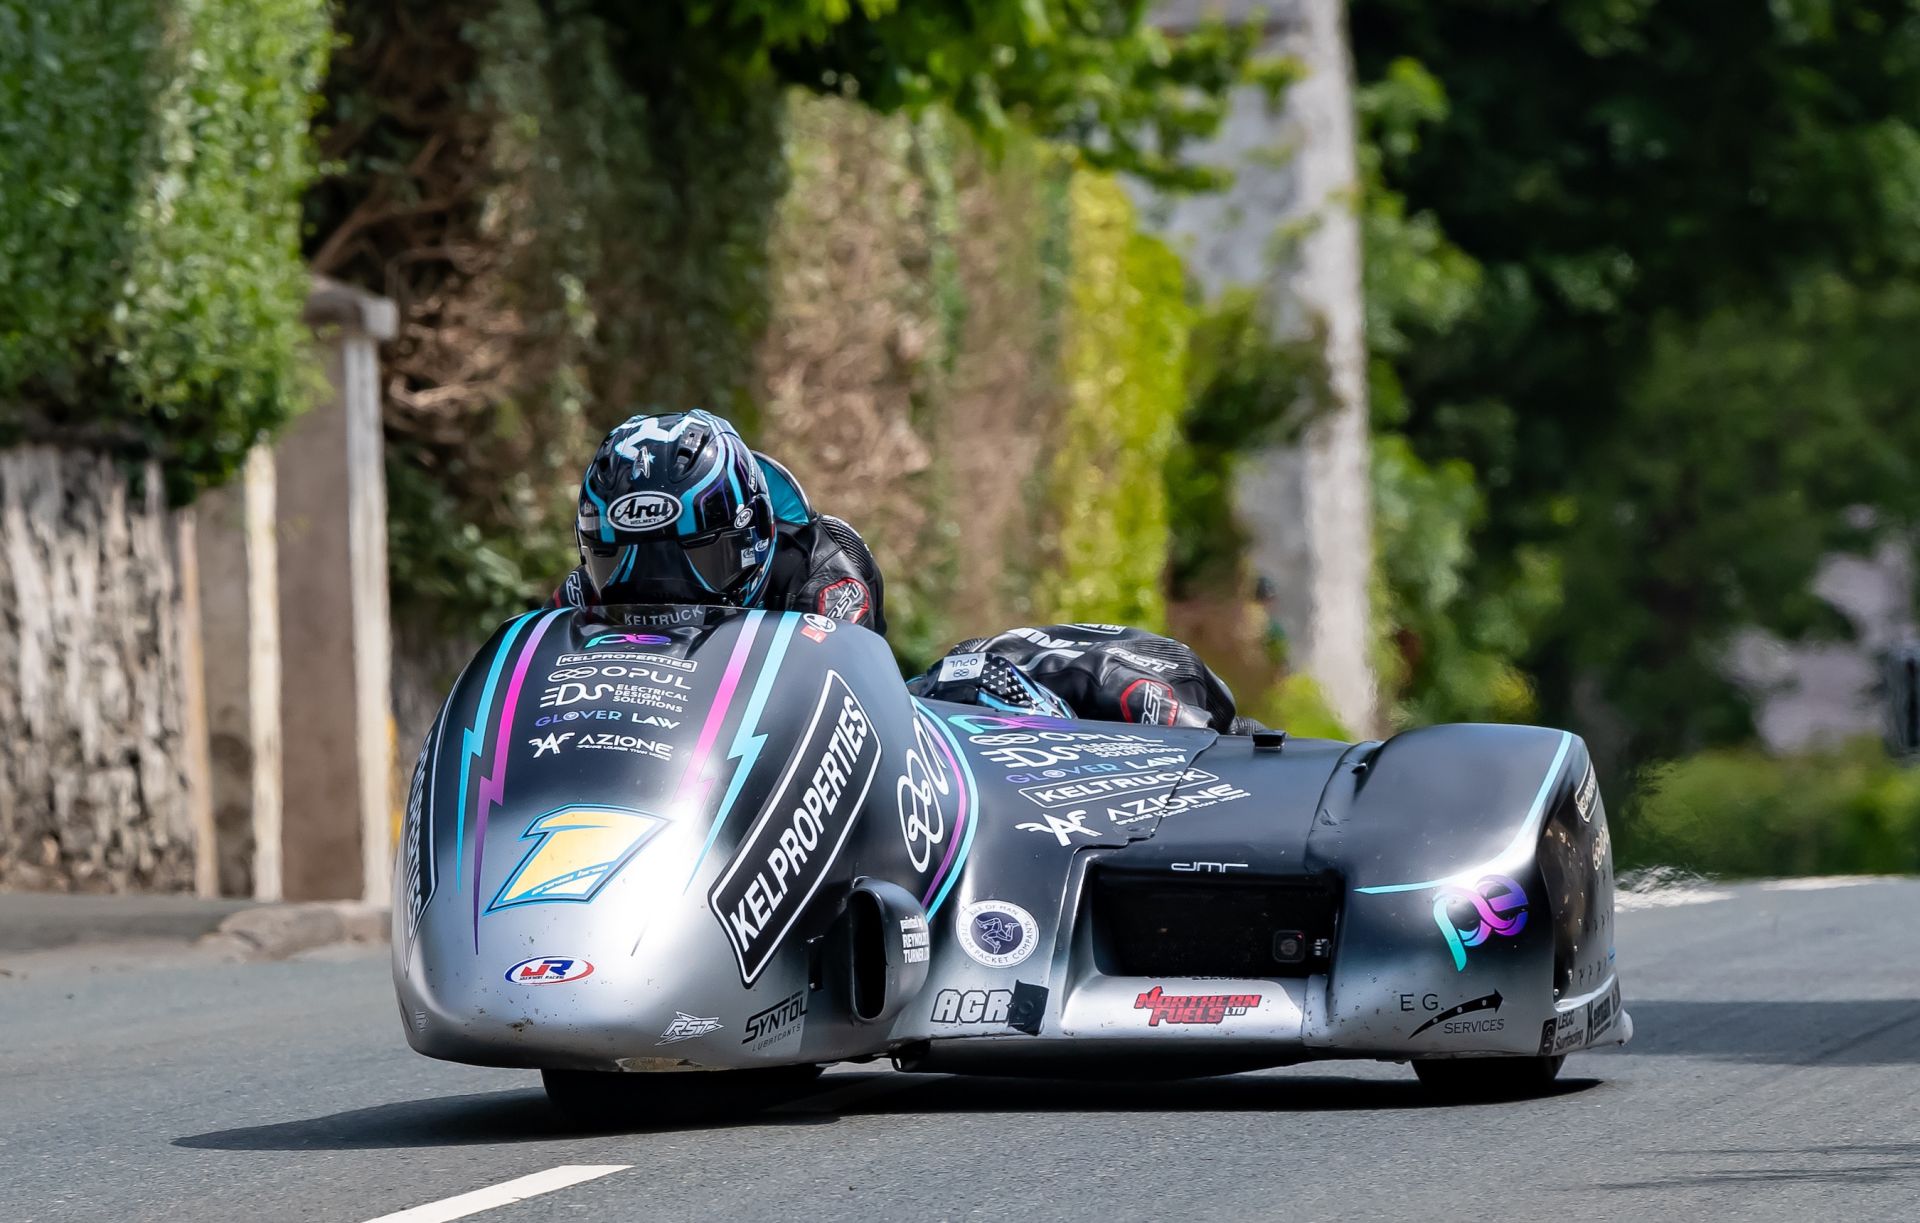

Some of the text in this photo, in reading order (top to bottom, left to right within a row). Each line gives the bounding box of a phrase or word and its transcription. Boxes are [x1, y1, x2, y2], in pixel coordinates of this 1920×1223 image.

[615, 498, 673, 520] Arai
[561, 653, 693, 669] KELPROPERTIES
[601, 666, 692, 690] OPUL
[613, 696, 683, 713] SOLUTIONS
[614, 690, 662, 701] DESIGN
[616, 684, 689, 702] ELECTRICAL
[535, 710, 681, 729] GLOVER LAW
[577, 733, 673, 757] AZIONE
[1006, 755, 1187, 784] GLOVER LAW
[1034, 770, 1208, 802] KELTRUCK
[1107, 784, 1244, 821] AZIONE
[729, 696, 868, 952] KELPROPERTIES
[975, 950, 1009, 964] PACKET
[1012, 920, 1034, 960] COMPANY
[1134, 986, 1262, 1010] NORTHERN
[661, 1015, 720, 1038] RST
[742, 991, 808, 1044] SYNTOL
[1148, 1005, 1248, 1026] FUELS LTD
[1443, 1018, 1505, 1034] SERVICES
[752, 1023, 802, 1051] LUBRICANTS
